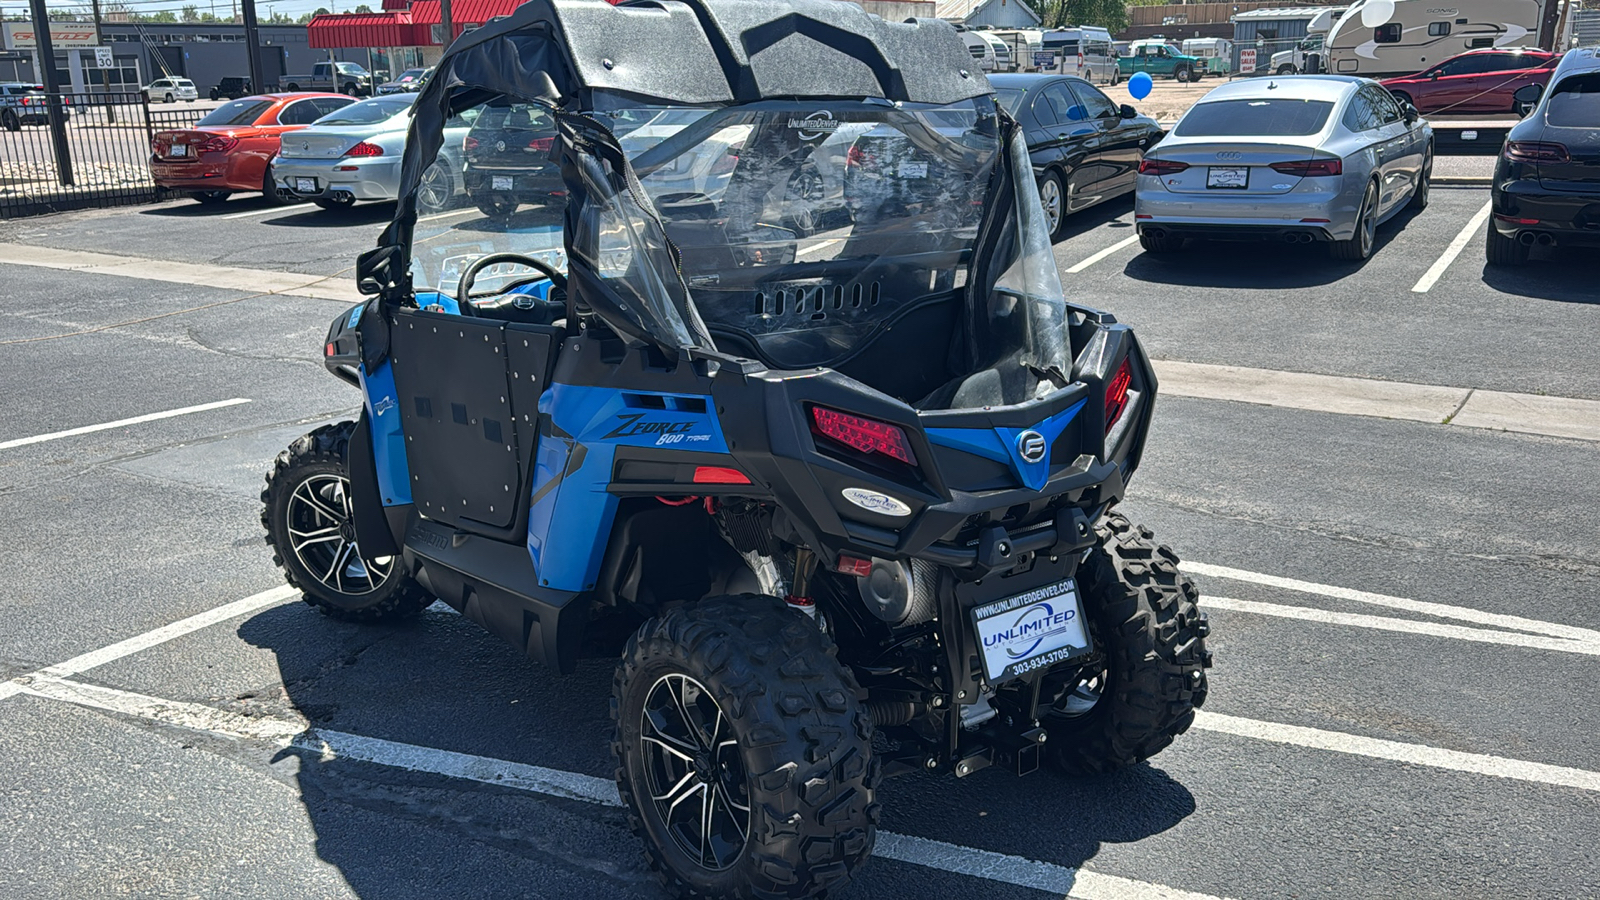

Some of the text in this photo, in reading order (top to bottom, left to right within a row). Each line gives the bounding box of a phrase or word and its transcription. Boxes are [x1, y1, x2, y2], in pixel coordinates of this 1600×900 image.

[99, 58, 112, 67] 30
[655, 433, 684, 445] 800
[853, 492, 898, 509] UNLIMITED
[983, 609, 1076, 647] UNLIMITED
[986, 640, 1014, 651] AUTO
[1012, 648, 1069, 676] 303-934-3705
